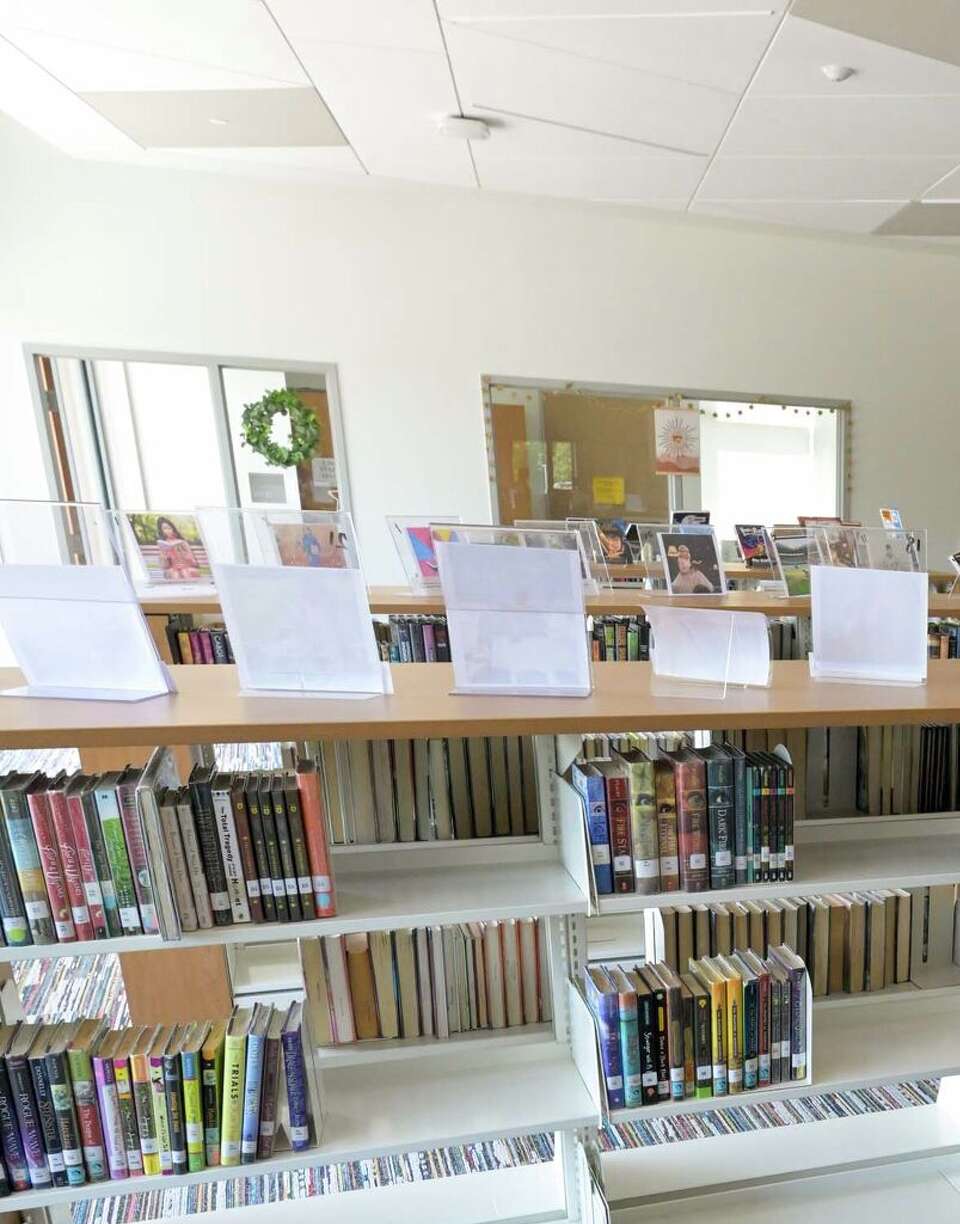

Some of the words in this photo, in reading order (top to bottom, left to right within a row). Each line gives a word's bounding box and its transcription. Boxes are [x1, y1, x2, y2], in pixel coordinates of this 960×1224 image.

[220, 814, 228, 833] Total
[717, 809, 727, 833] DARK
[223, 833, 233, 862] Tragedy
[718, 835, 728, 851] FIR
[230, 1064, 239, 1099] TRIALS
[18, 1093, 36, 1128] ROGUE
[27, 1130, 41, 1157] WAVE
